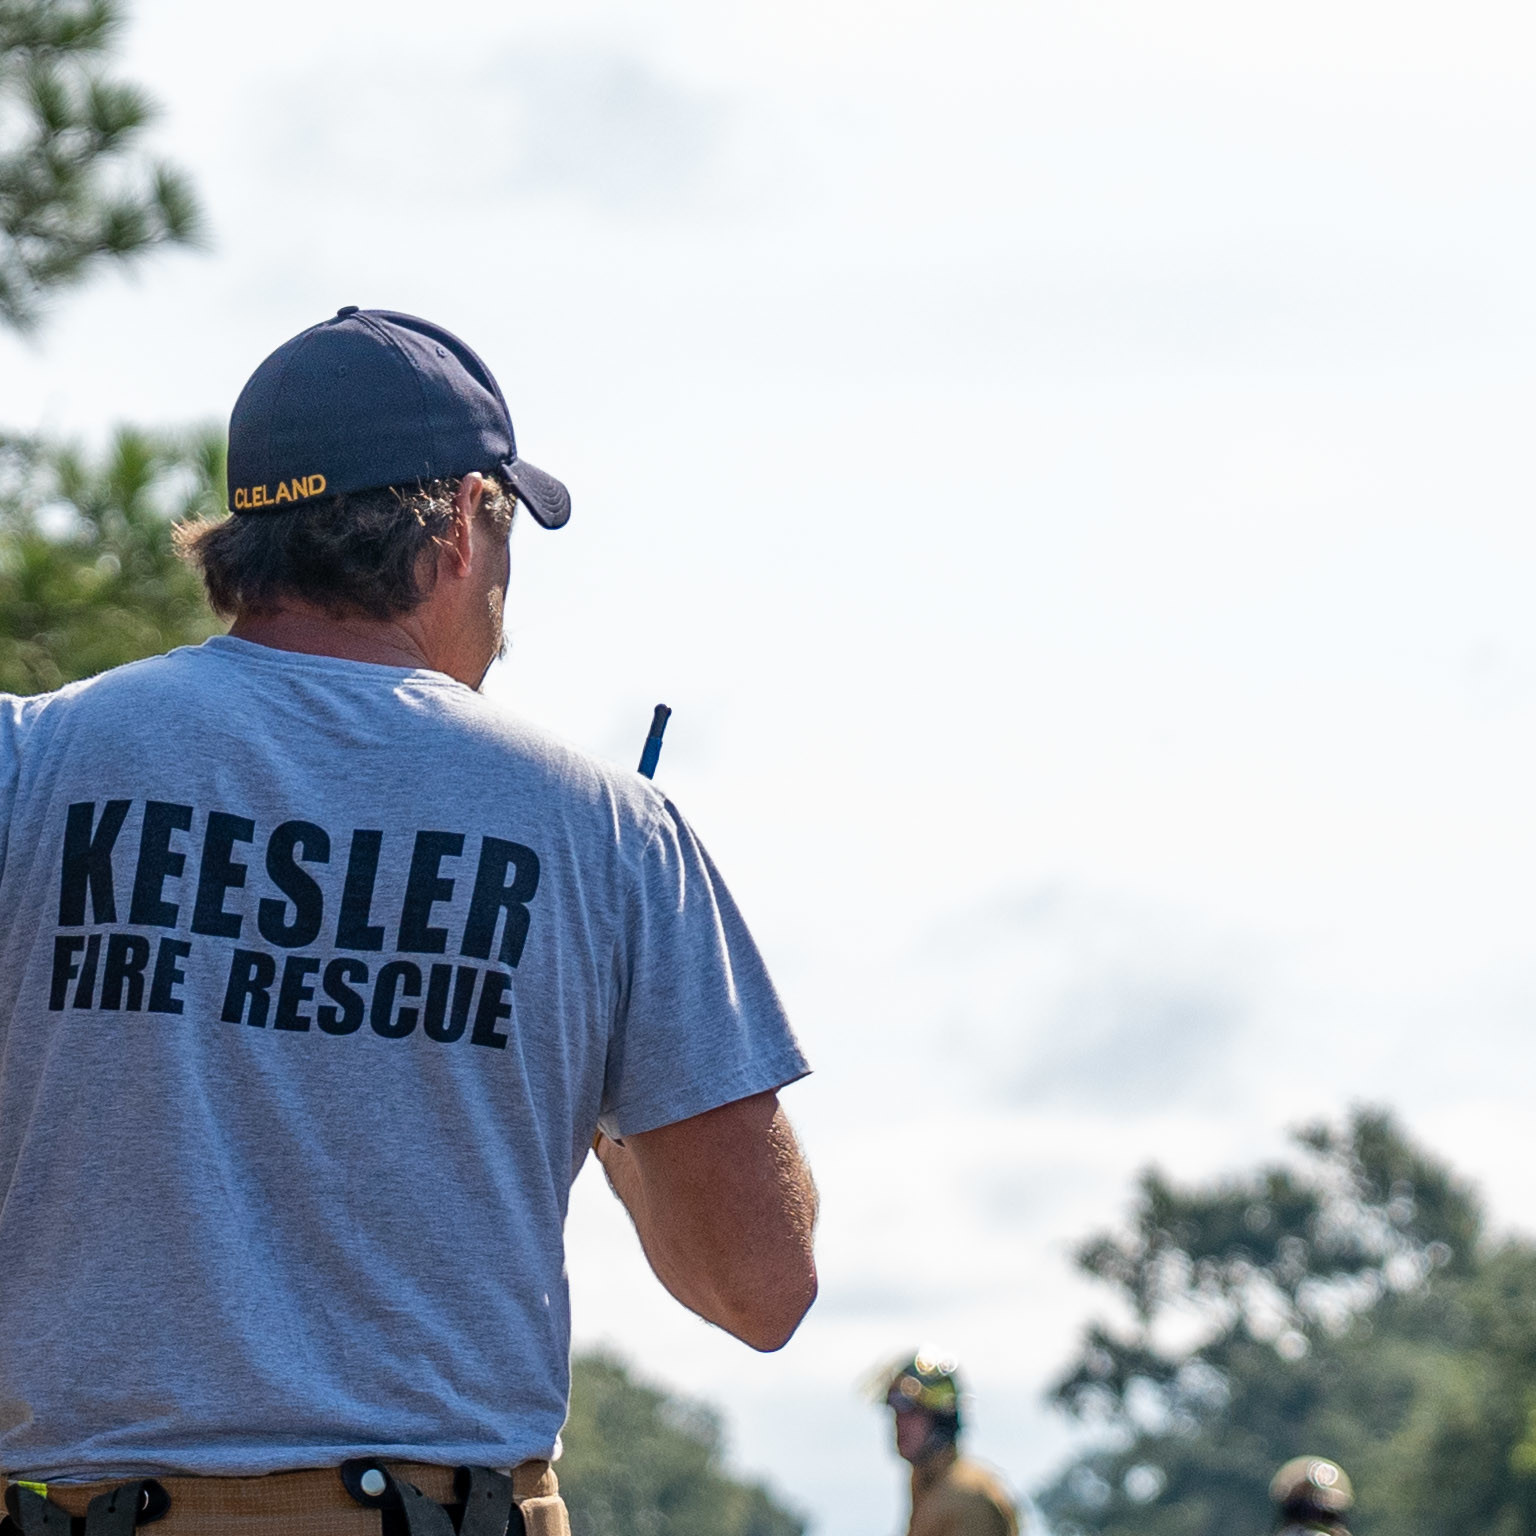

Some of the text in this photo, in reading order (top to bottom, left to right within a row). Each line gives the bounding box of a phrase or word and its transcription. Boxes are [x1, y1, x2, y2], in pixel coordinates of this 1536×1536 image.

[234, 474, 327, 510] CLELAND
[58, 800, 541, 968] KEESLER
[48, 932, 514, 1050] FIRE RESCUE
